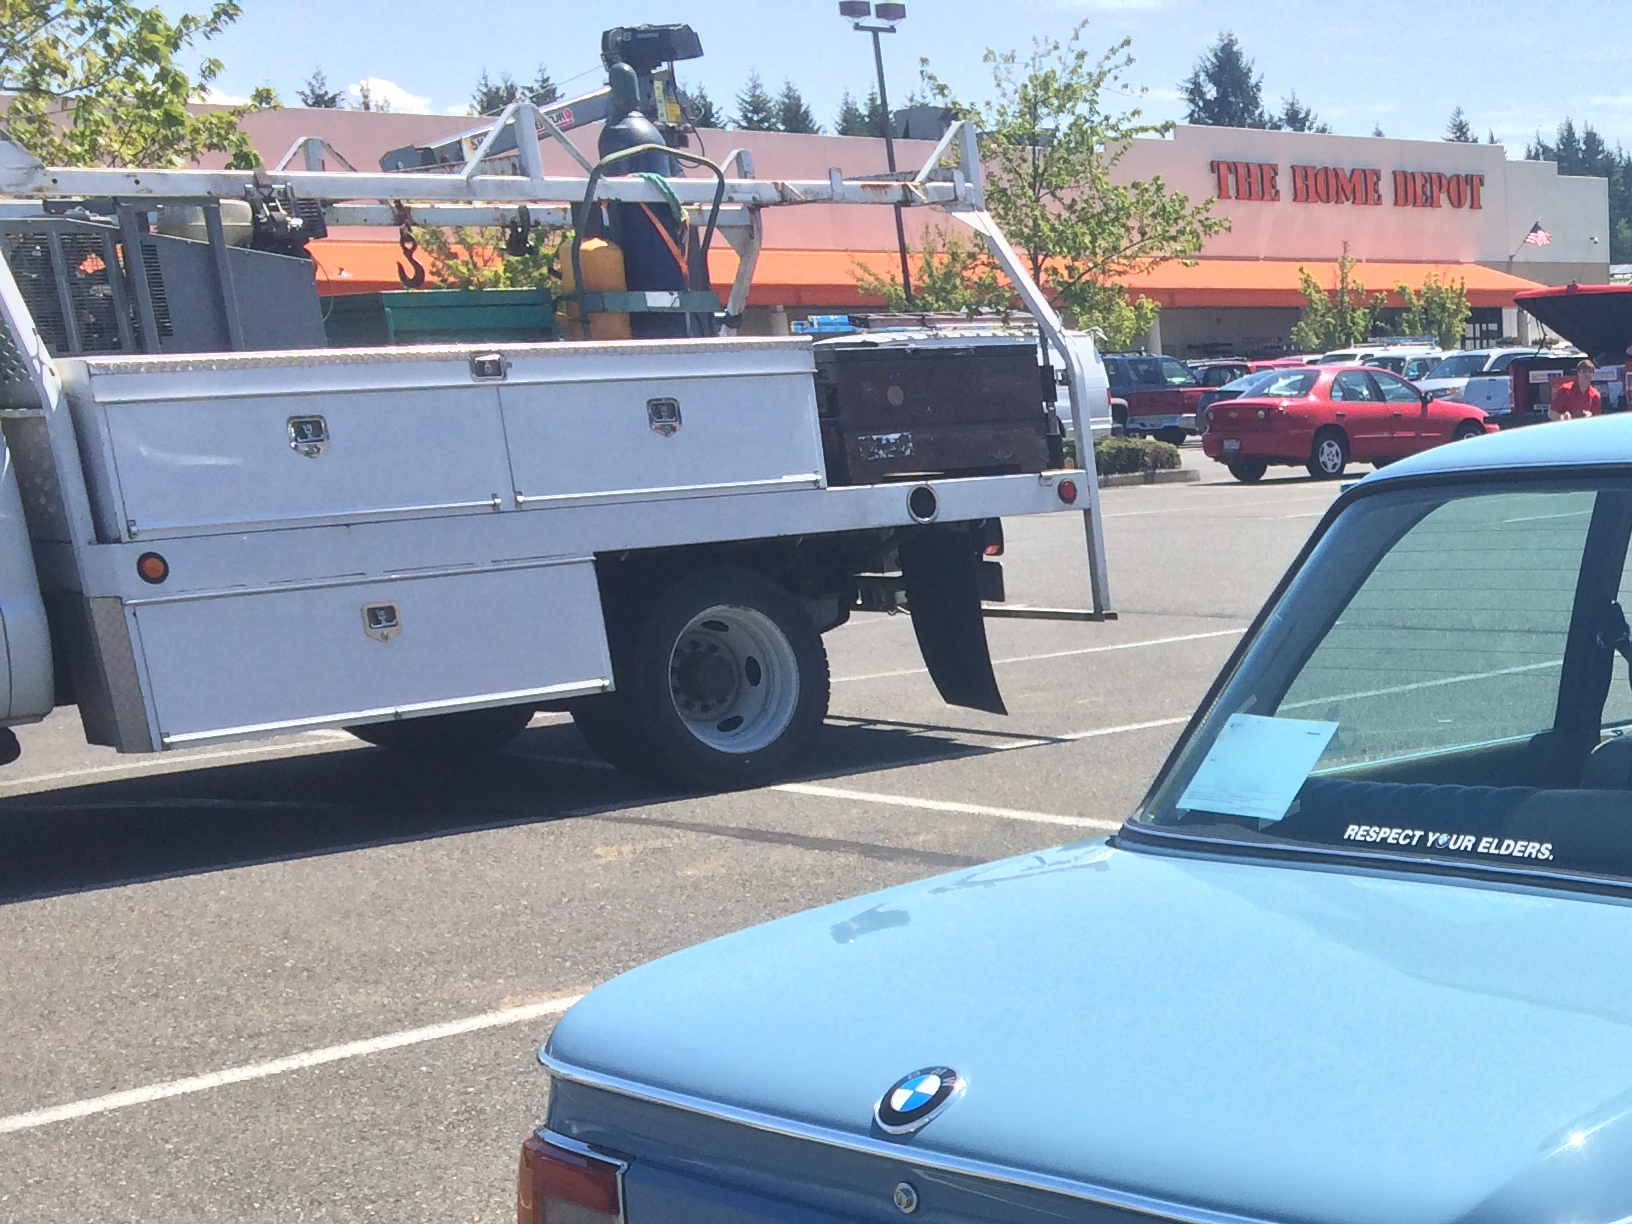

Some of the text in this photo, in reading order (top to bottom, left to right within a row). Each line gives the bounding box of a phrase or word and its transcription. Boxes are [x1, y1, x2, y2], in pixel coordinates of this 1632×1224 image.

[1210, 160, 1485, 210] THE HOME DEPOT
[1343, 824, 1555, 861] RESPECT YOUR ELDERS.
